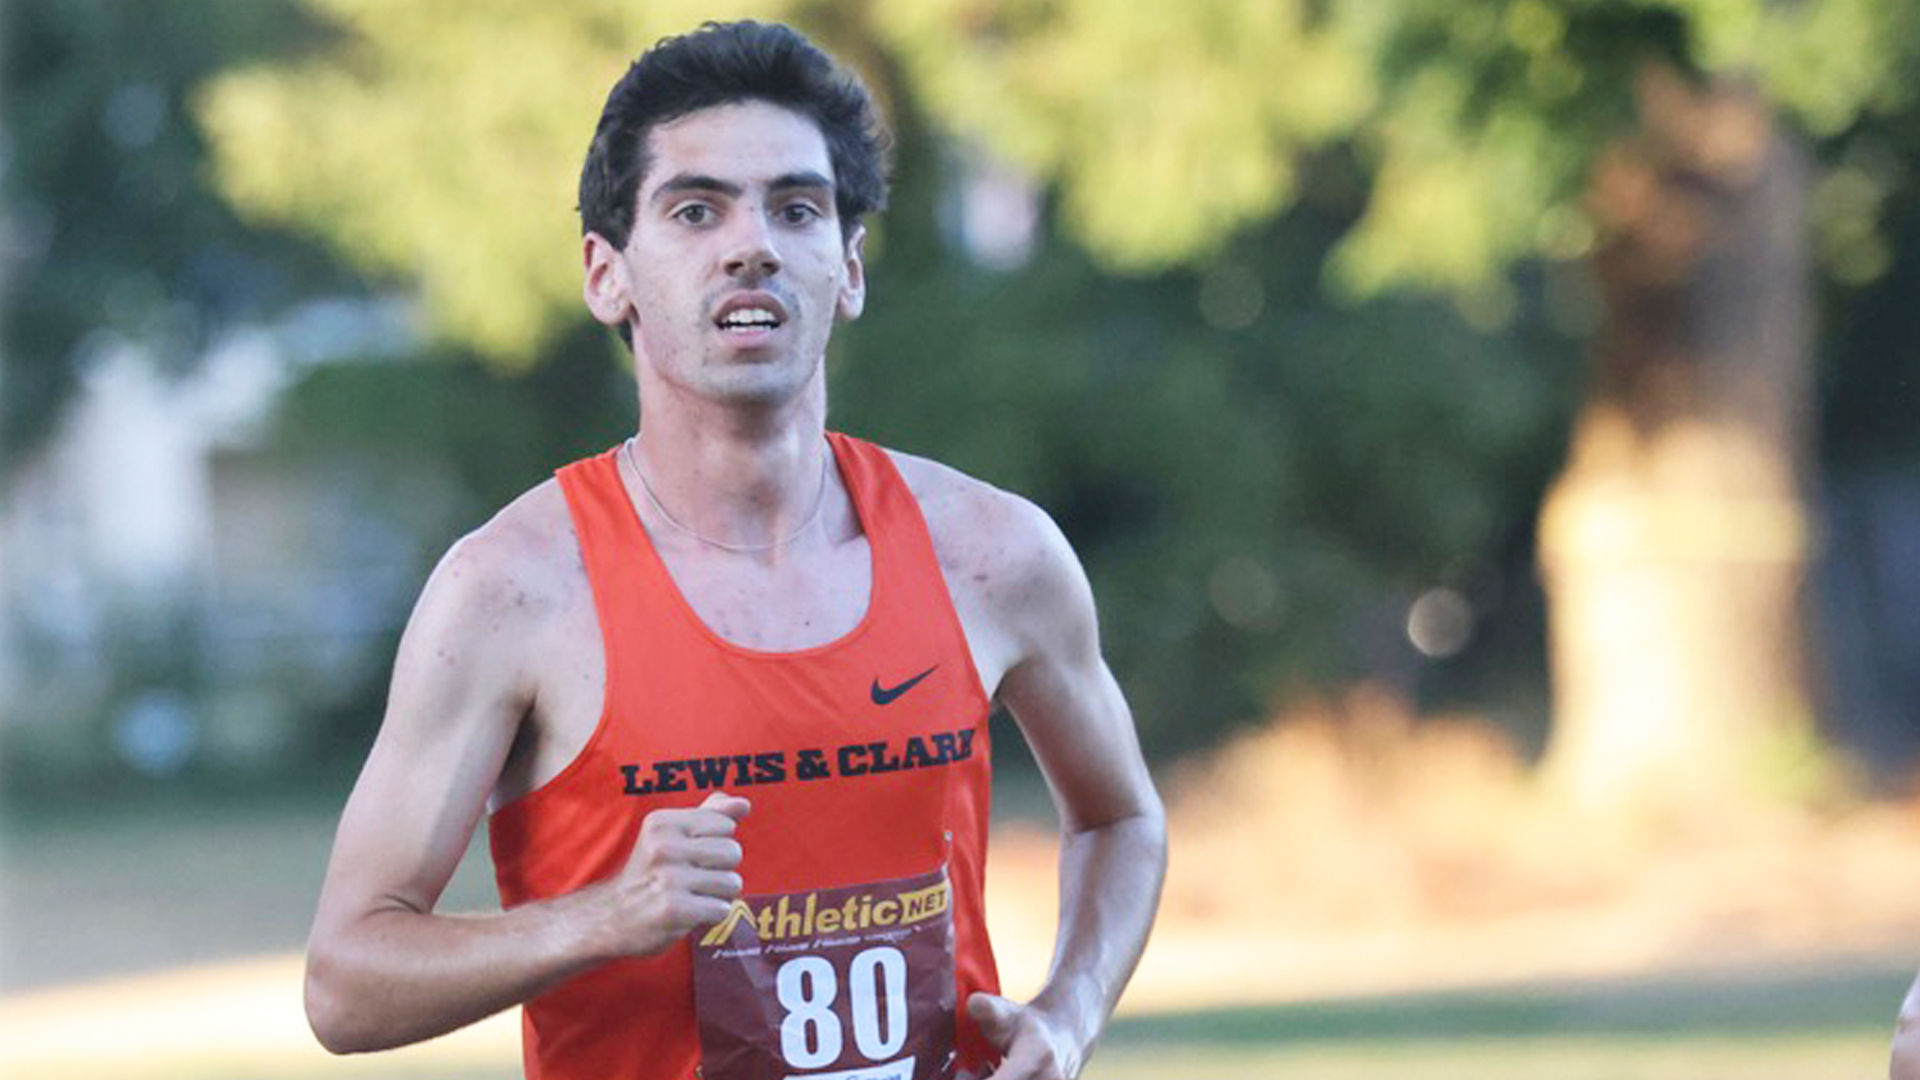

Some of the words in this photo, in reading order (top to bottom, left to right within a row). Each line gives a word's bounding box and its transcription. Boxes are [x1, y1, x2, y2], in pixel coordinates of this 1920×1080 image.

[620, 752, 786, 795] LEWIS
[796, 749, 830, 781] &
[700, 892, 899, 946] Athletic
[908, 889, 945, 917] NET
[776, 946, 908, 1069] 80
